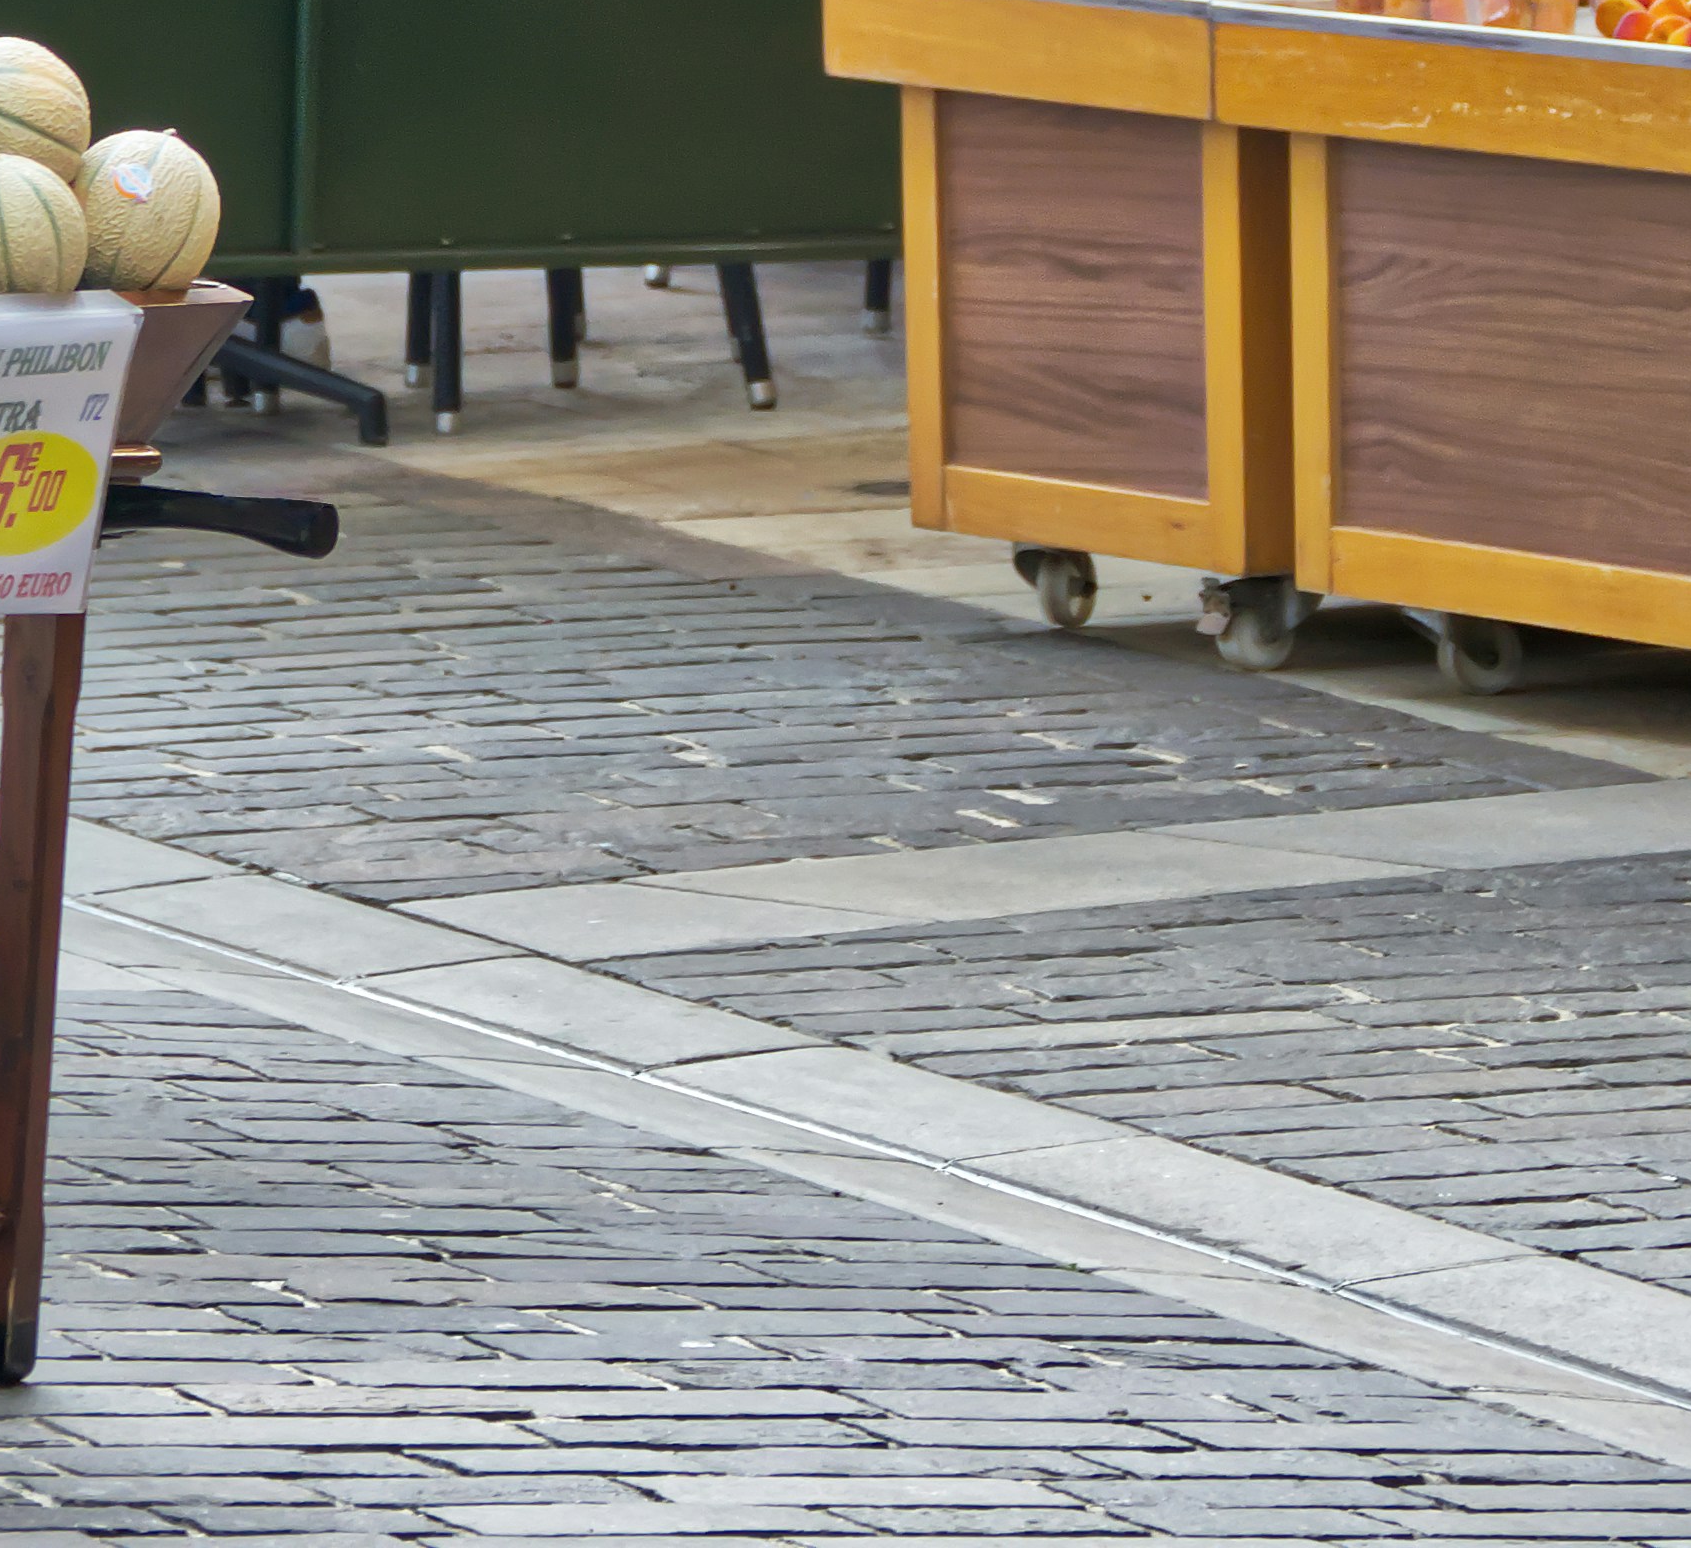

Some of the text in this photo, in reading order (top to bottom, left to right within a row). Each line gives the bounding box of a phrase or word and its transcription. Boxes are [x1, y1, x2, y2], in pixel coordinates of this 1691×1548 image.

[2, 341, 113, 378] PHILIBON
[79, 394, 109, 422] 172
[16, 572, 72, 598] EURO
